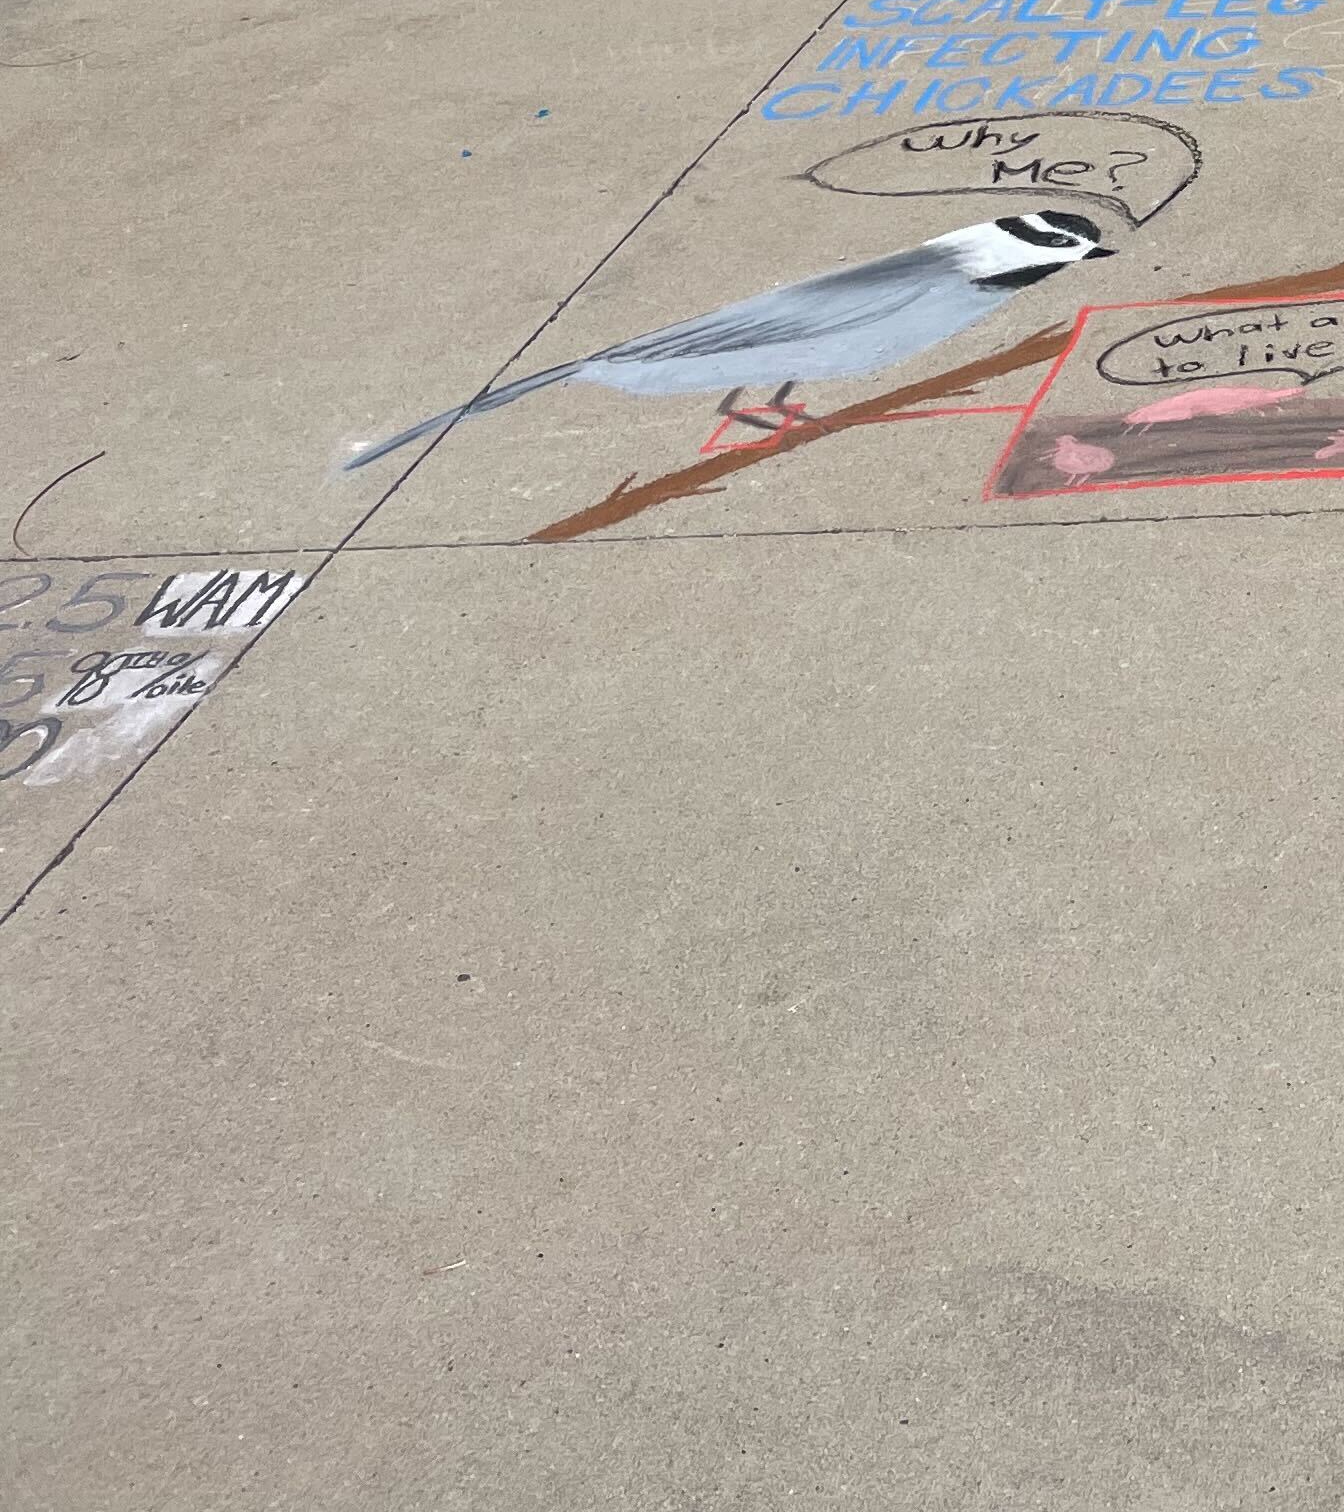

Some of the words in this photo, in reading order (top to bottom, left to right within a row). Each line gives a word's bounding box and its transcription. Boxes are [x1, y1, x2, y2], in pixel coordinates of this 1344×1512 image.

[816, 24, 1263, 72] INFECTING
[1310, 316, 1340, 329] a
[1152, 357, 1206, 378] to
